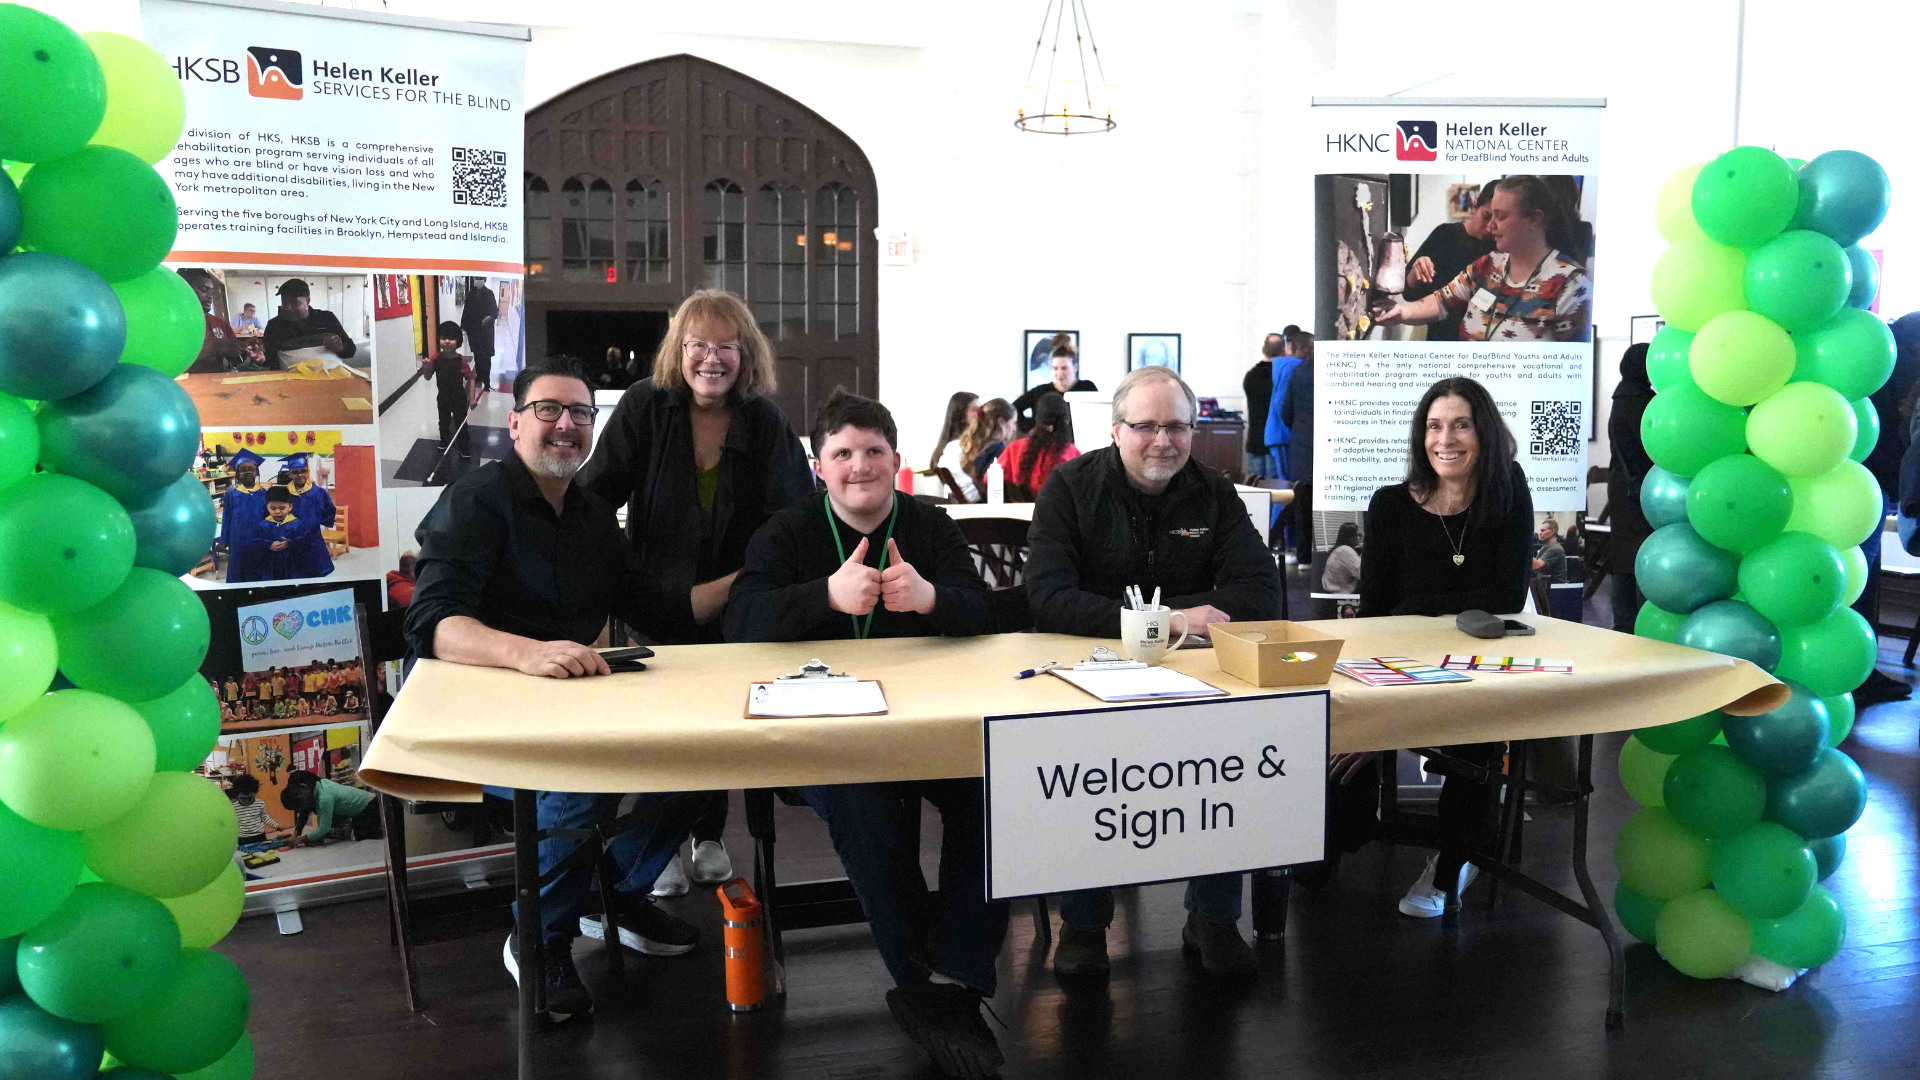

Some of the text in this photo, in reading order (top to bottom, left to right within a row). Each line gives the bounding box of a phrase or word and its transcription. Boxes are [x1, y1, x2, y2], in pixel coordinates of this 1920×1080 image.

[313, 60, 439, 87] Helen Keller
[313, 80, 511, 111] SERVICES FOR THE BLIND
[1446, 122, 1548, 137] Helen Keller
[187, 128, 231, 139] division
[238, 132, 250, 140] of
[257, 133, 284, 144] HKS,
[291, 135, 320, 146] HKSB
[327, 138, 335, 147] is
[356, 142, 434, 153] comprehensive
[1326, 133, 1390, 153] HKNC
[1445, 139, 1569, 151] NATIONAL CENTER
[173, 142, 434, 166] ehabilitation program serving individuals of all
[1445, 152, 1589, 163] for DeafBlind Youths and Adults
[174, 157, 201, 167] ages
[205, 157, 229, 166] who
[233, 160, 252, 168] are
[256, 159, 284, 170] blind
[303, 163, 328, 172] have
[332, 165, 362, 175] vision
[366, 167, 385, 176] loss
[389, 169, 409, 178] and
[412, 170, 435, 179] who
[174, 170, 435, 192] may have additional disabilities, living in the New
[175, 182, 309, 198] York metropolitan area.
[177, 206, 508, 231] Serving the five boroughs of New York City and Long Island, HKSB
[177, 222, 509, 244] operates training facilities in Brooklyn, Hempstead and Islandia.
[1326, 361, 1357, 370] (HKNC)
[1396, 362, 1412, 370] only
[1457, 362, 1516, 370] comprehensive
[1485, 372, 1512, 380] youths
[1367, 381, 1397, 389] hearing
[1359, 399, 1390, 408] provides
[1391, 399, 1418, 407] vocatio
[1358, 437, 1389, 445] provides
[1342, 447, 1375, 455] adaptive
[1349, 456, 1382, 464] mobility,
[1343, 484, 1374, 492] regional
[1324, 494, 1358, 502] training,
[306, 605, 352, 628] CHK
[1036, 744, 1286, 800] Welcome &
[1094, 798, 1234, 849] Sign In
